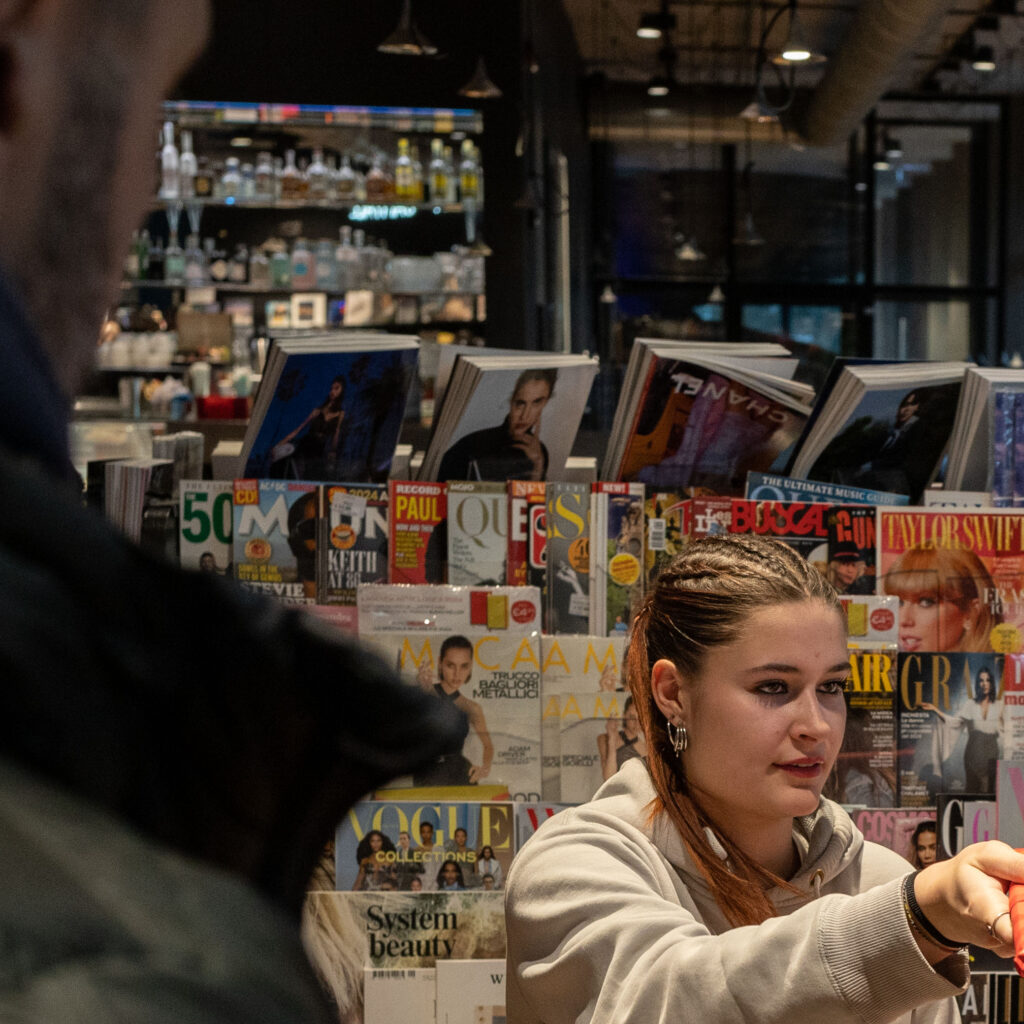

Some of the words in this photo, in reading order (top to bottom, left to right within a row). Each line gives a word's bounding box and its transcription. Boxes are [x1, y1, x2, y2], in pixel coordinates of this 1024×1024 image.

[671, 373, 788, 423] CHANEL
[396, 485, 441, 495] RECORD
[762, 476, 782, 487] THE
[784, 479, 833, 495] ULTIMATE
[836, 487, 865, 500] MUSIC
[396, 496, 442, 521] PAUL
[882, 514, 961, 551] TAYLOR
[328, 551, 377, 573] KEITH
[479, 680, 538, 690] BAGLIORI
[493, 672, 540, 680] TRUCCO
[472, 690, 539, 699] METALLICI
[351, 804, 510, 849] VOGUE
[375, 851, 477, 863] COLLECTIONS
[366, 905, 458, 938] System
[369, 932, 458, 959] beauty
